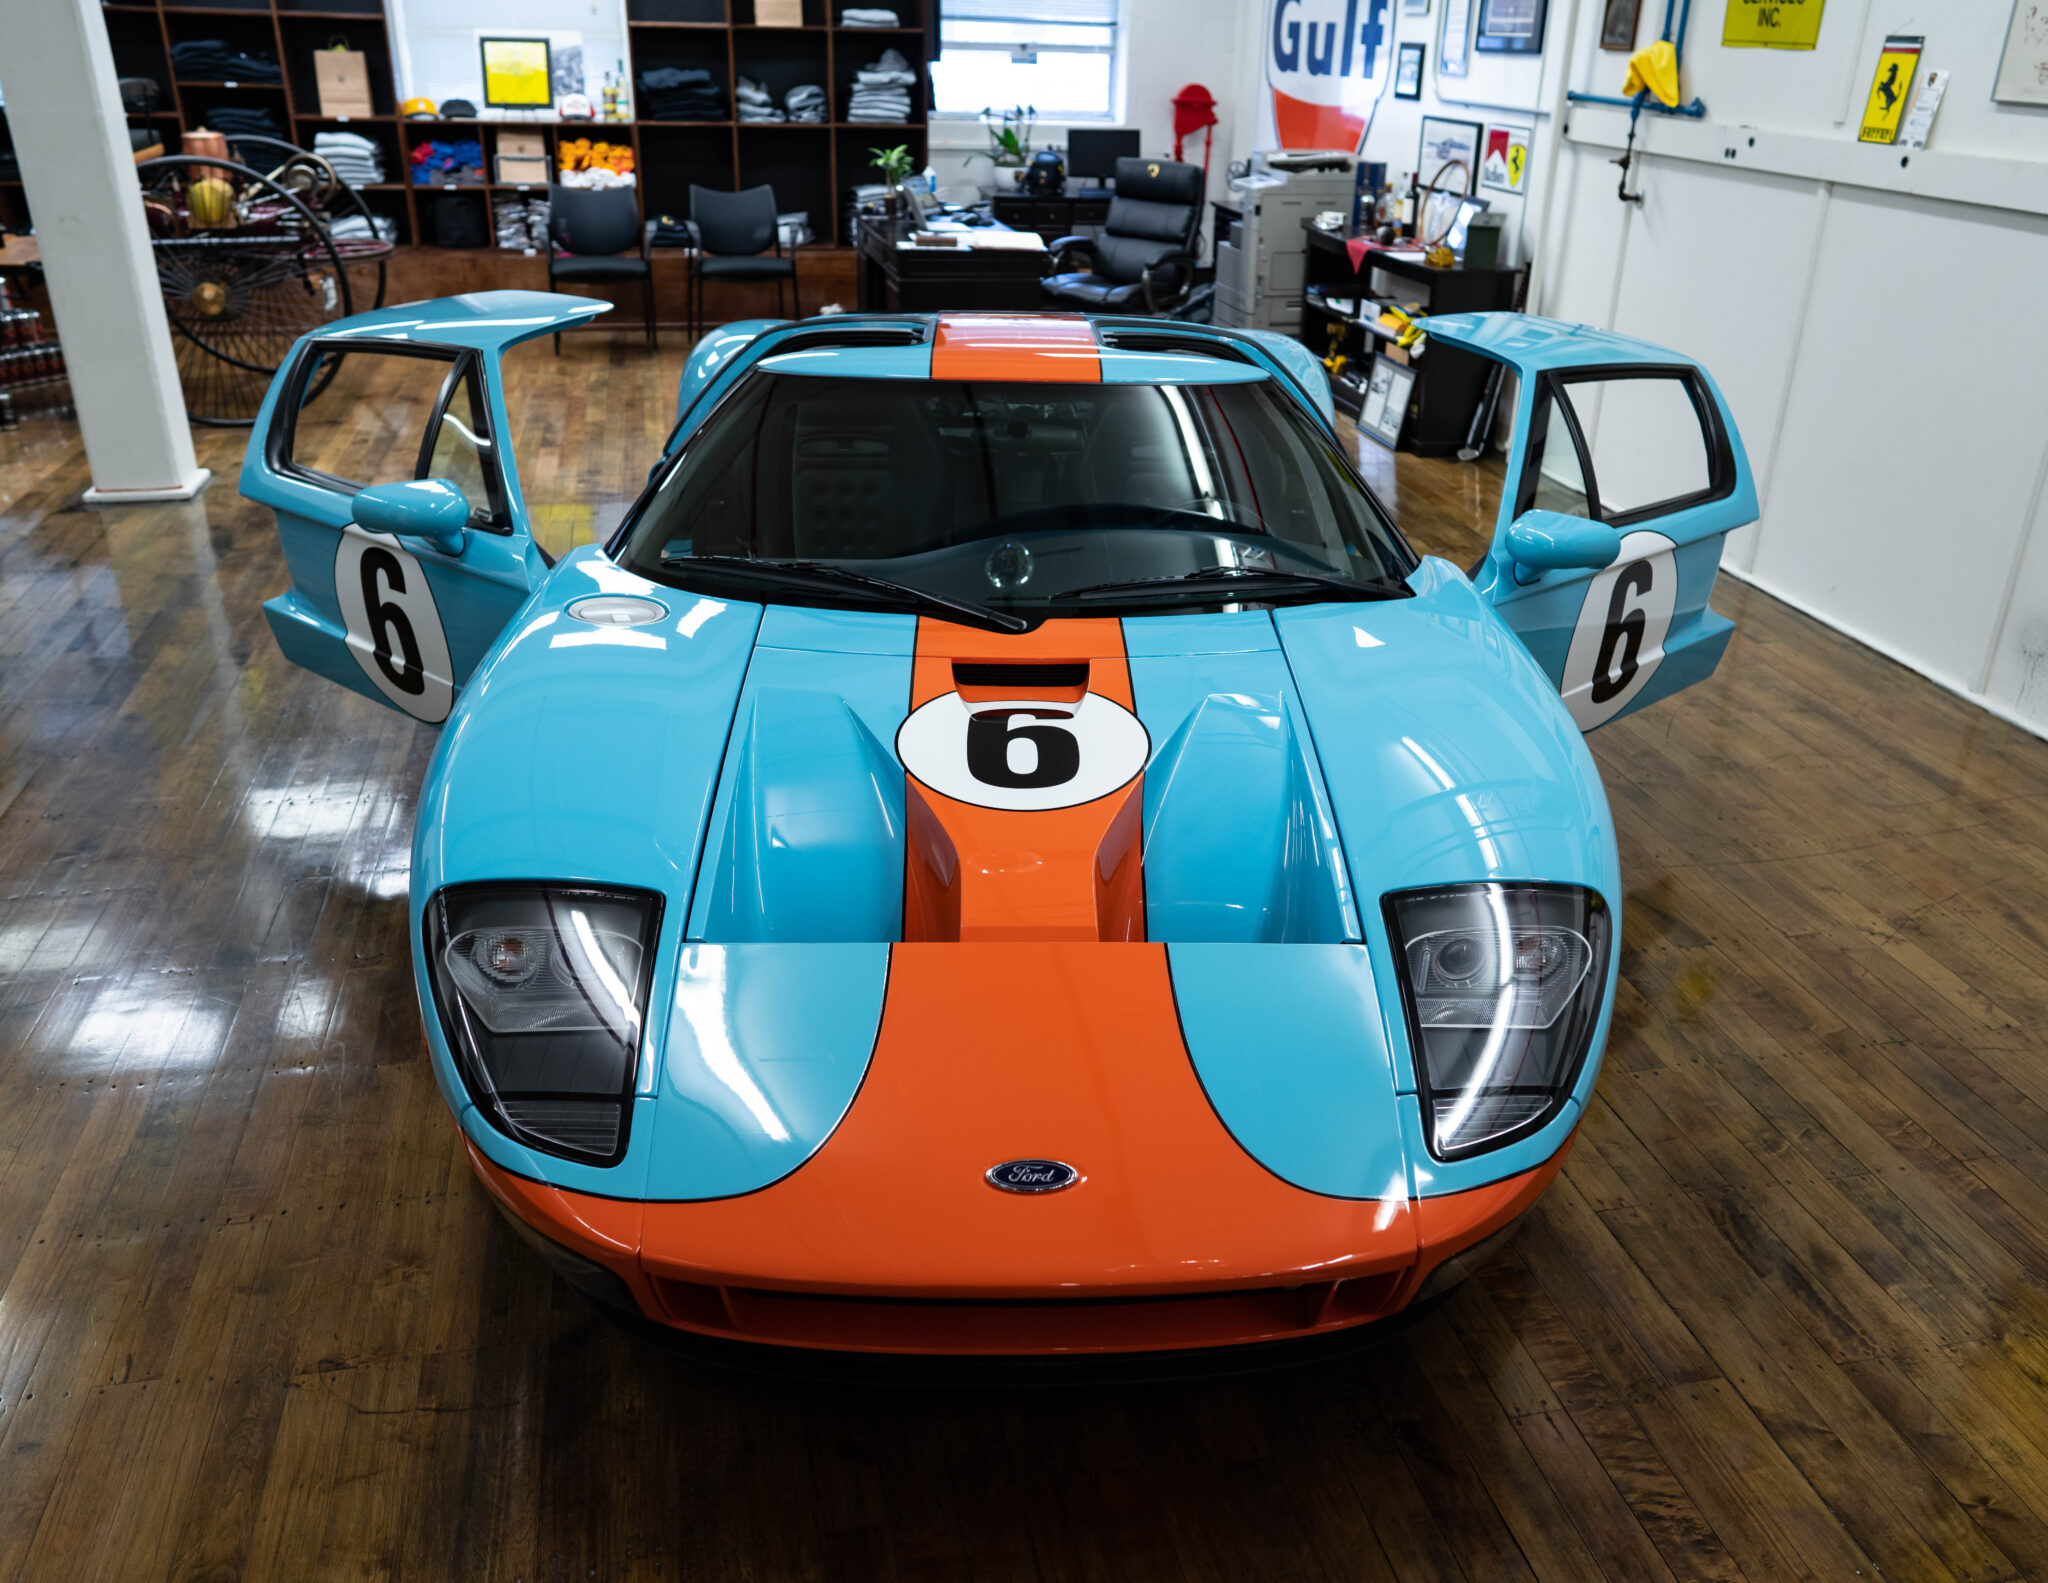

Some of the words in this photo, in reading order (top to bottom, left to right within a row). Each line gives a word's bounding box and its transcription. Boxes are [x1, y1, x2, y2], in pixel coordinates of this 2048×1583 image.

[1273, 0, 1388, 79] Gulf
[359, 546, 425, 696] 6
[1591, 559, 1654, 704] 6
[966, 708, 1080, 789] 6
[1008, 1165, 1055, 1182] Ford
